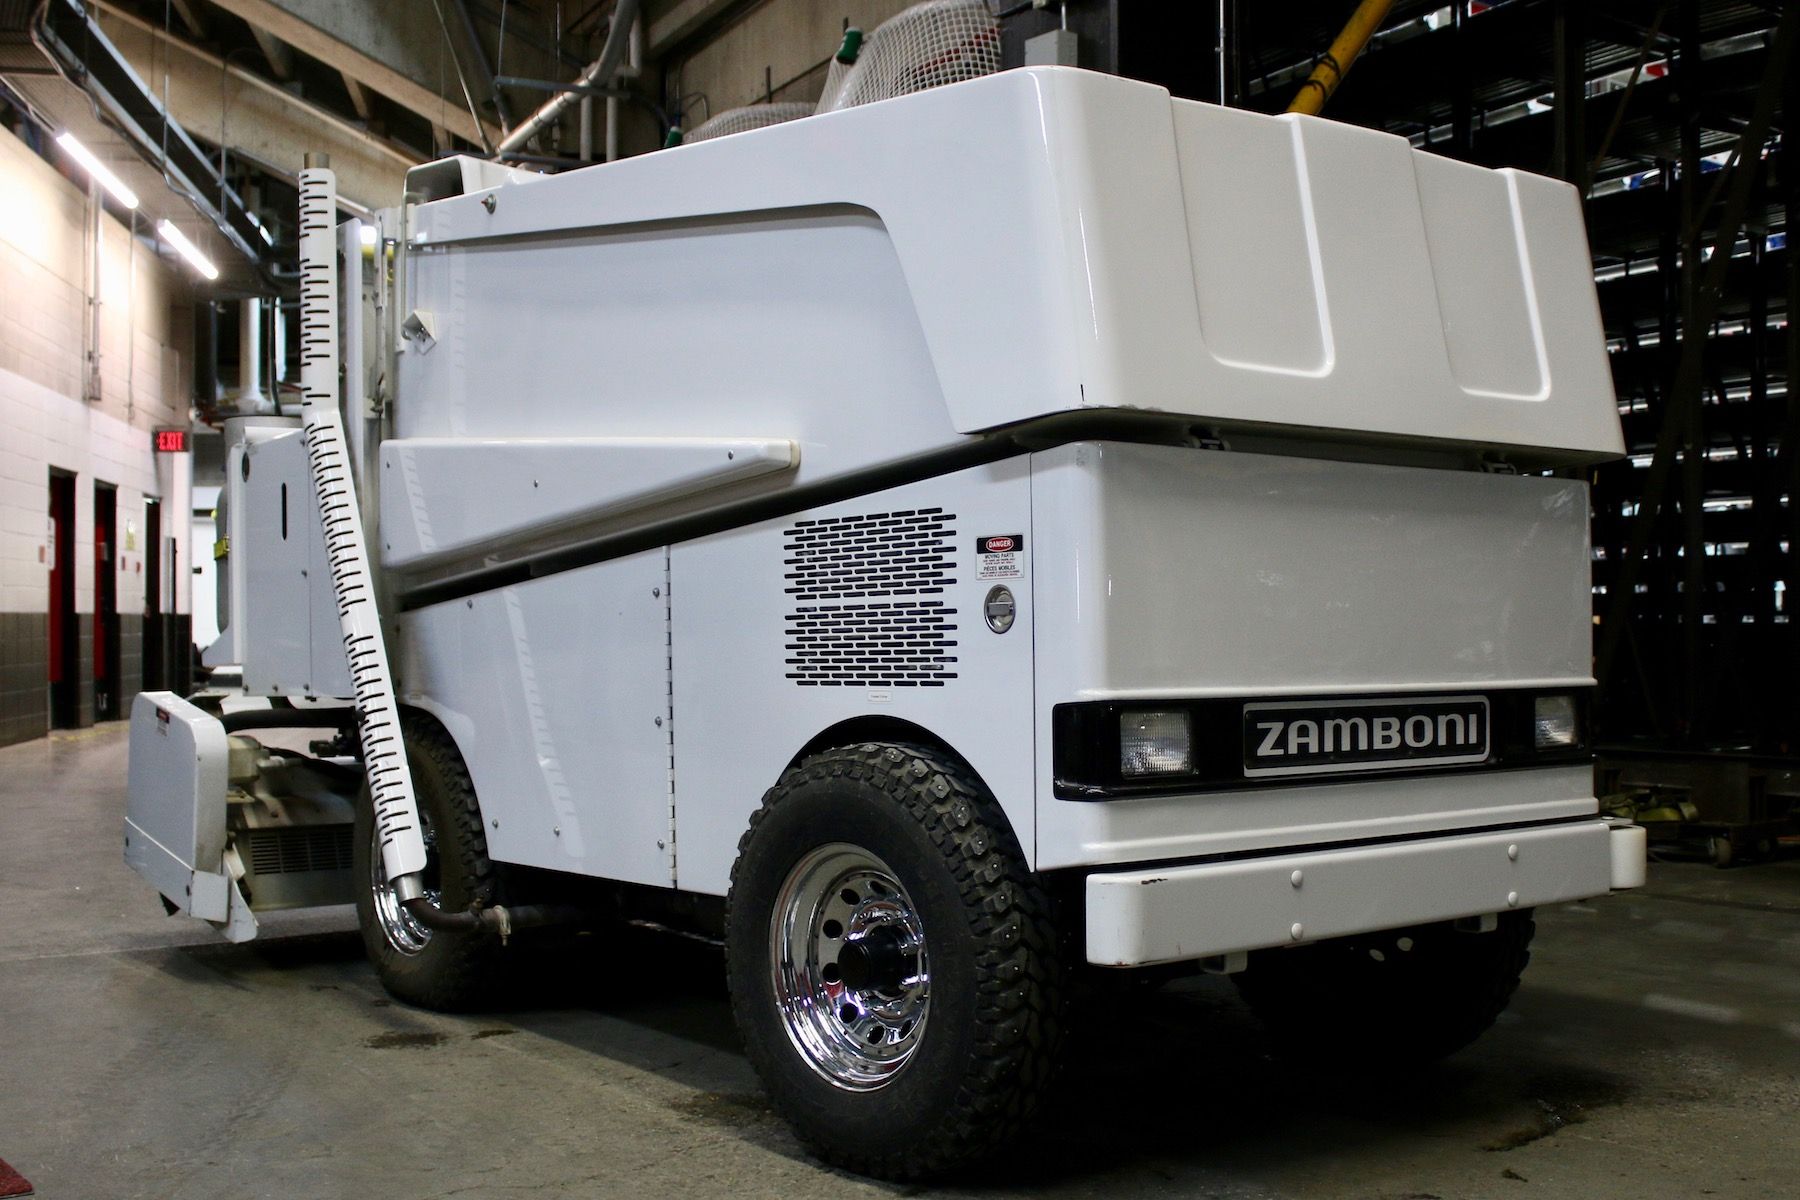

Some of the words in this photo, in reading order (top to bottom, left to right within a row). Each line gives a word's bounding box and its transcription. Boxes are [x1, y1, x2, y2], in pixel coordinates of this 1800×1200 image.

[158, 431, 183, 450] EXIT
[988, 540, 1011, 548] DANGER
[1257, 713, 1477, 756] ZAMBONI
